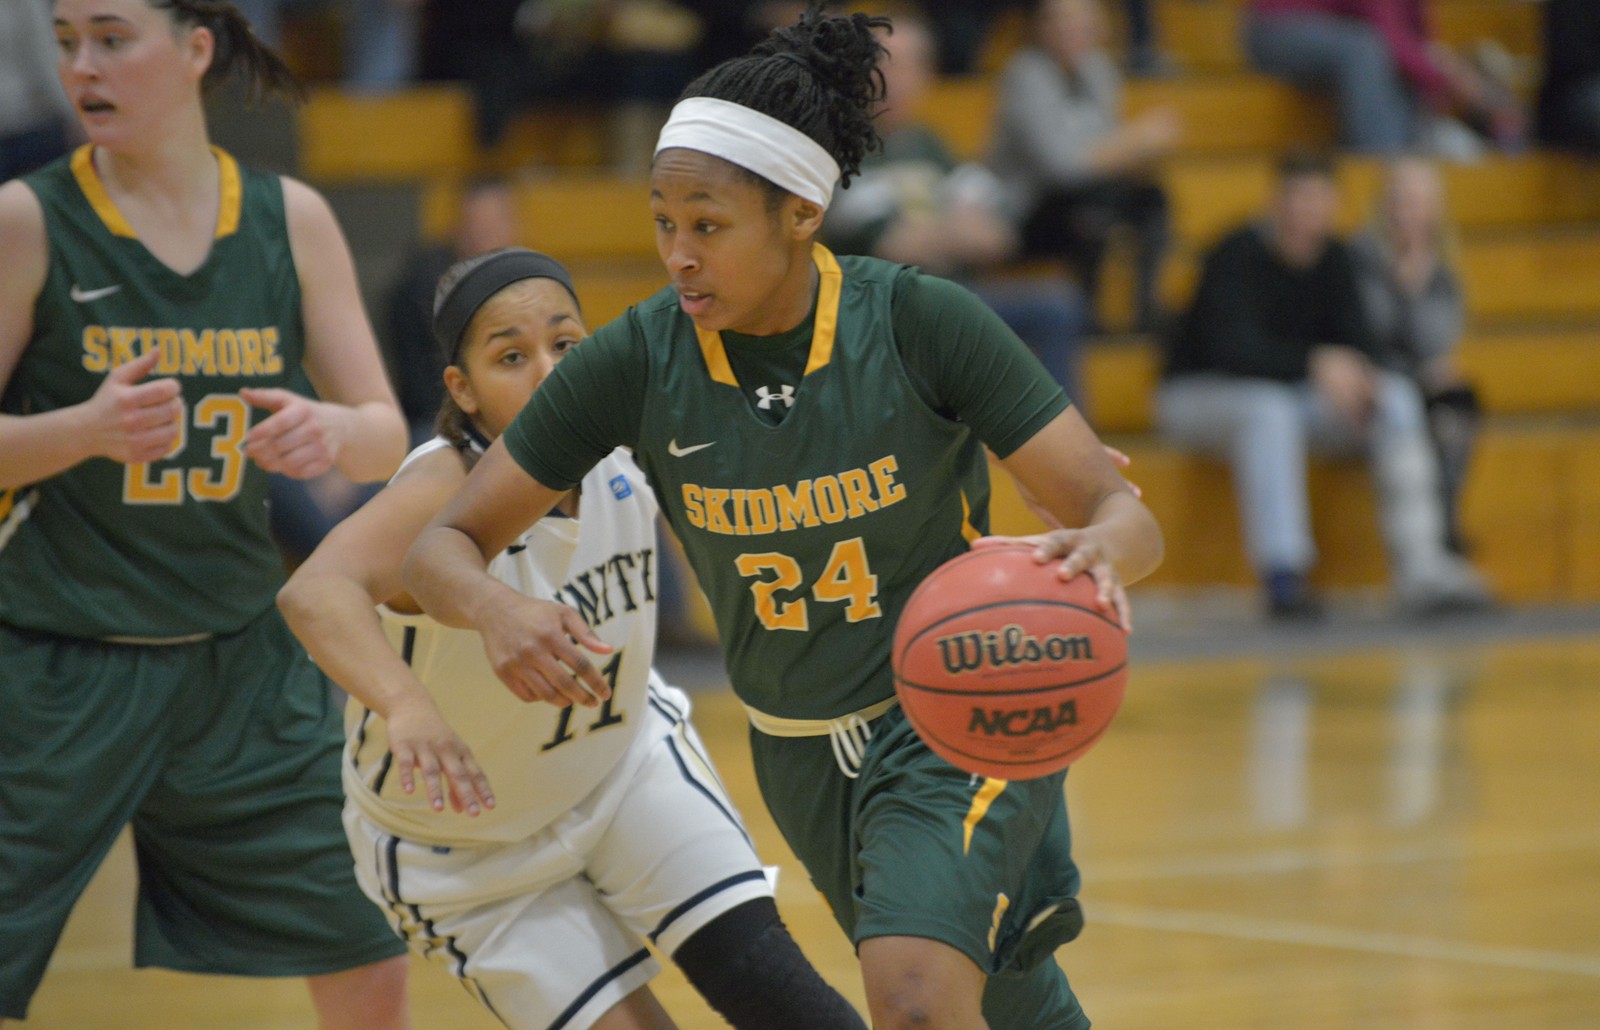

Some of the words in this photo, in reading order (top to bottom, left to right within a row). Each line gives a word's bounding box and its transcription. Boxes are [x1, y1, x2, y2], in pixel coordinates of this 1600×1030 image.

[82, 325, 283, 376] SKIDMORE
[122, 394, 250, 505] 23
[682, 454, 907, 535] SKIDMORE
[734, 536, 883, 632] 24
[937, 625, 1094, 676] Wilson
[968, 699, 1079, 737] NCAA
